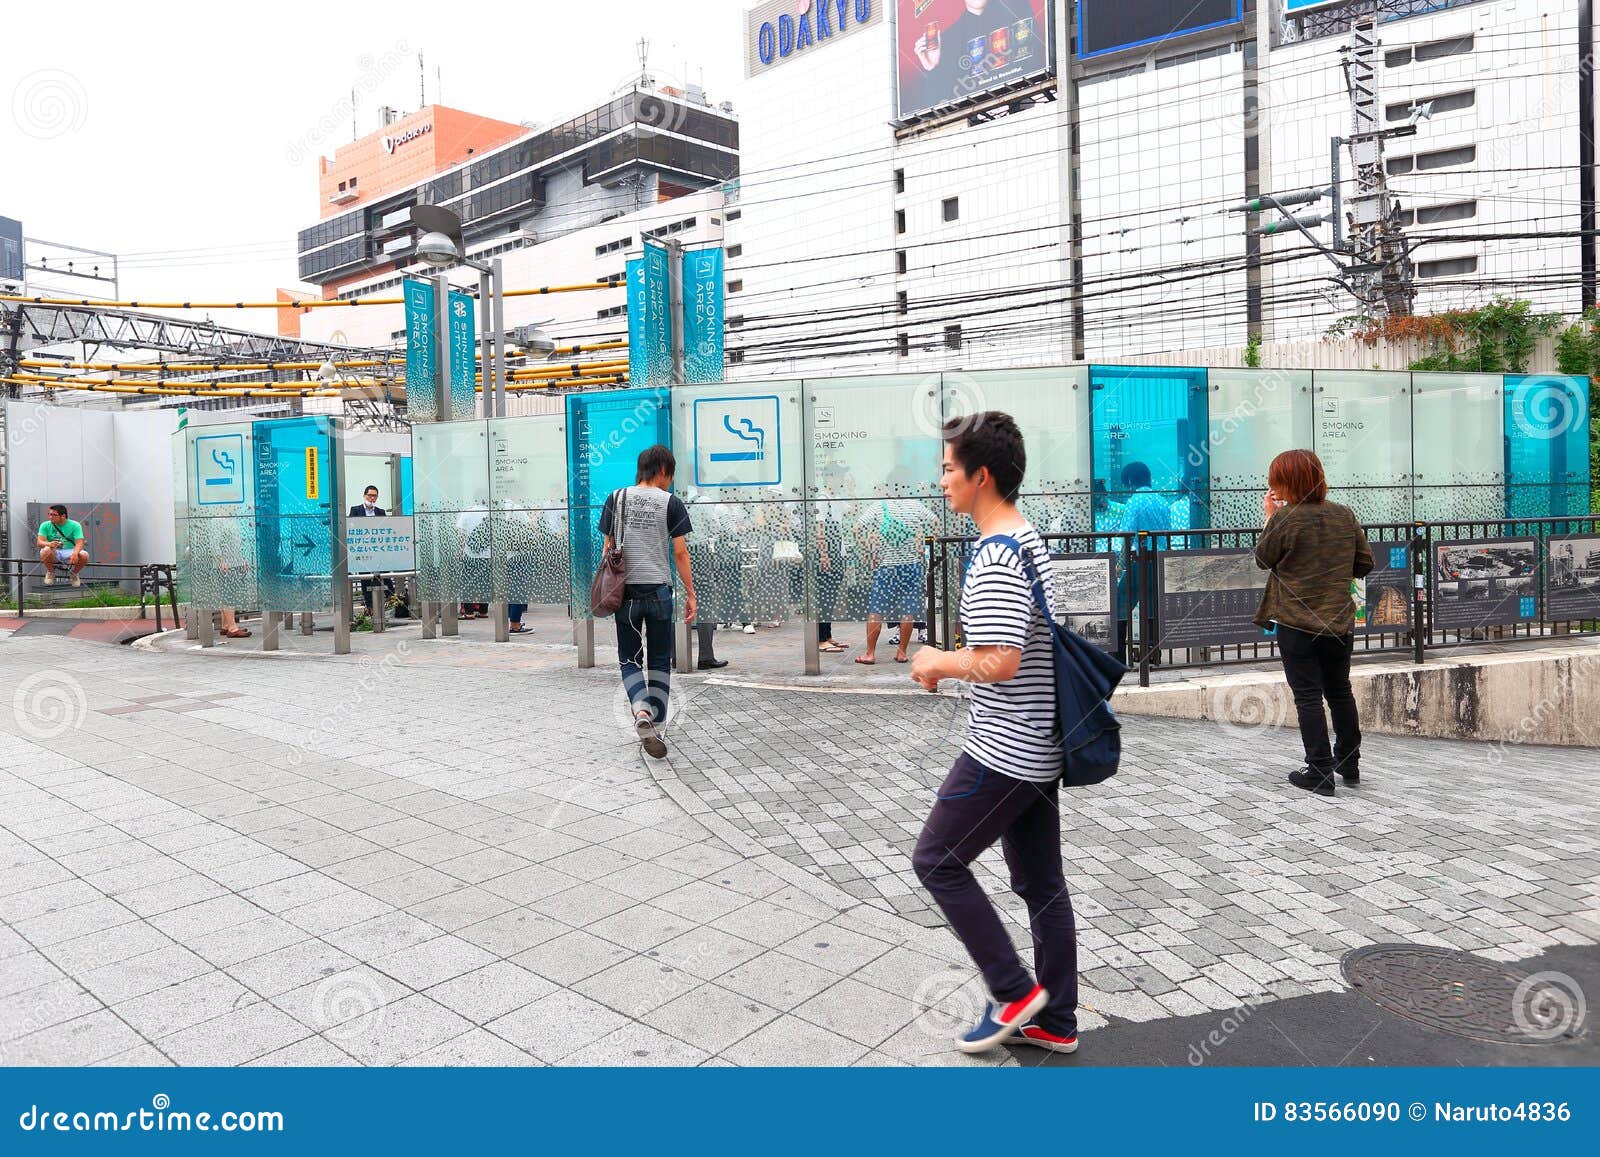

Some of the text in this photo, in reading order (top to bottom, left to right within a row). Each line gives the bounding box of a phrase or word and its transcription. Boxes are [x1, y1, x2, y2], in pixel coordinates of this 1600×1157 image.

[758, 0, 870, 65] ODAKYU
[638, 291, 646, 323] CITY
[649, 278, 658, 321] AREA
[696, 283, 704, 324] AREA
[656, 280, 667, 353] SMOKING
[705, 281, 716, 353] SMOKING
[412, 311, 420, 349] AREA
[421, 313, 429, 378] SMOKING
[814, 431, 868, 440] SMOKING
[1103, 422, 1152, 430] SMOKING
[1103, 431, 1130, 440] AREA
[1322, 422, 1365, 430] SMOKING
[1511, 423, 1549, 431] SMOKING
[579, 443, 621, 451] SMOKING
[814, 441, 845, 449] AREA
[495, 458, 528, 466] SMOKING
